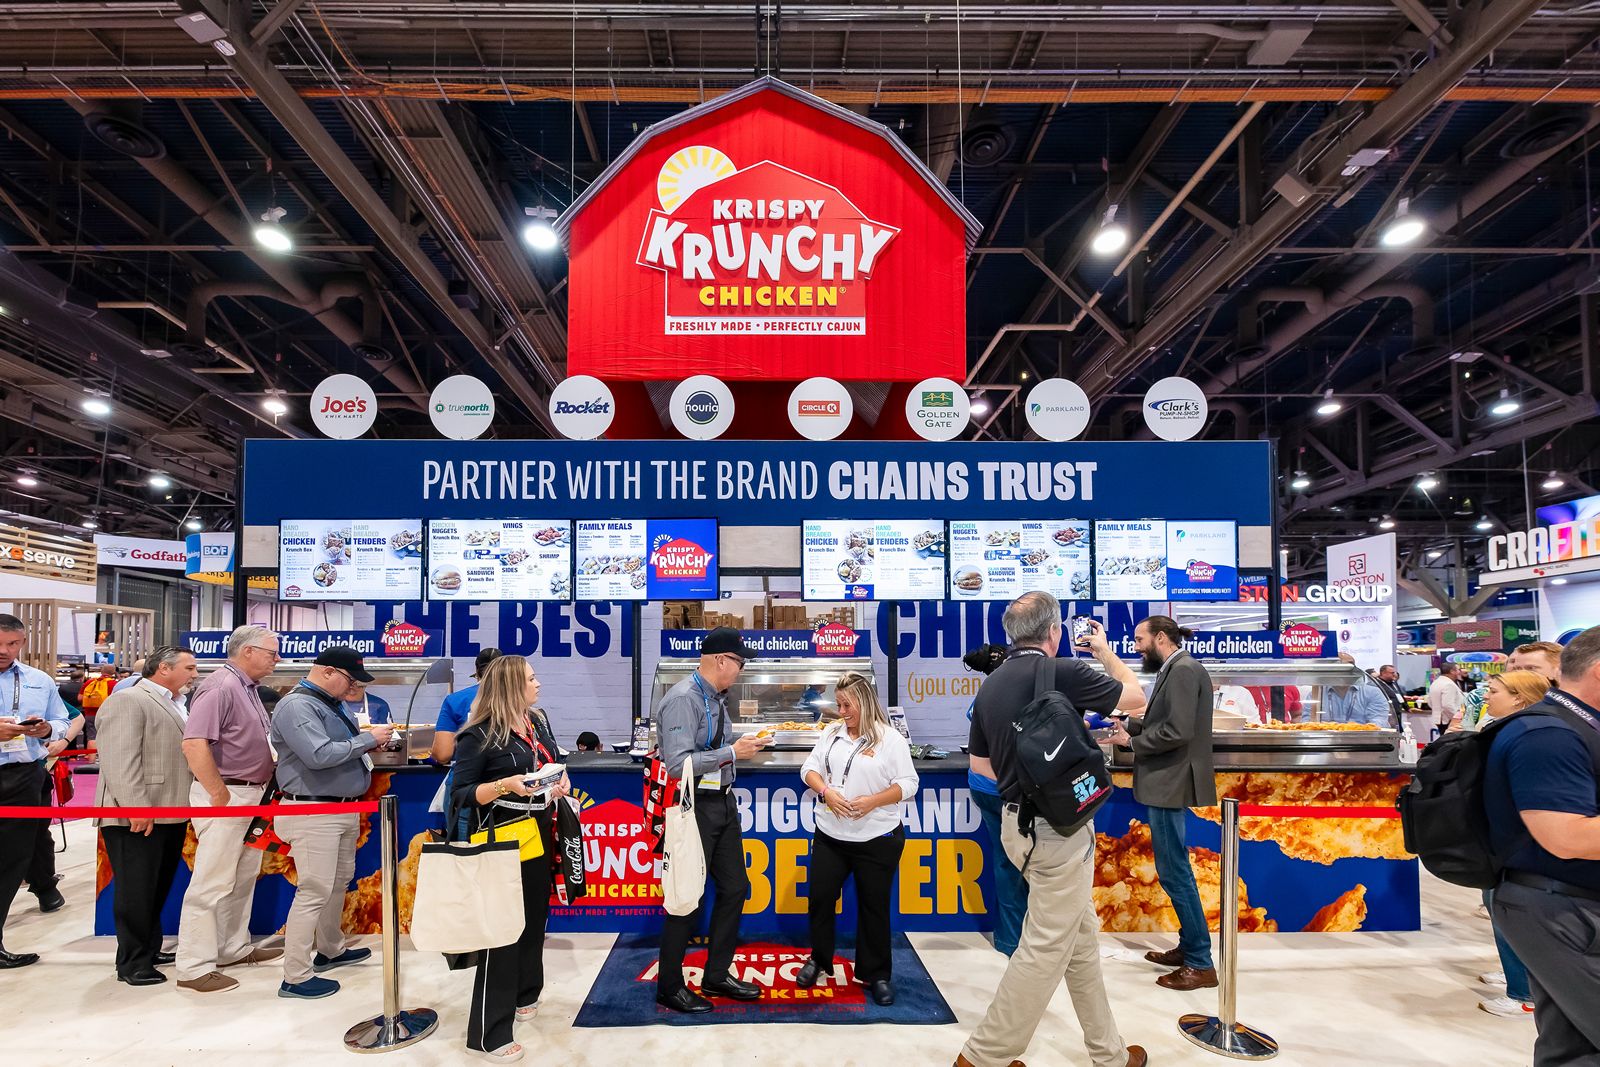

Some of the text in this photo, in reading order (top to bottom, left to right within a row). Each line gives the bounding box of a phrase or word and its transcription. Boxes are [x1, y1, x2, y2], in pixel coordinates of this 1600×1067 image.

[713, 199, 825, 220] KRISPY
[645, 216, 892, 281] KRUNCHY
[669, 321, 861, 332] FRESHLY MADE PERFECTLY CAJUN
[321, 396, 367, 413] Joe's
[448, 403, 489, 411] truenorth
[554, 398, 610, 414] Rocket
[685, 402, 719, 413] nouria
[1161, 402, 1199, 411] Clark's
[917, 410, 960, 419] GOLDEN
[925, 419, 952, 428] GATE
[423, 460, 1097, 501] PARTNER WITH THE BRAND CHAINS TRUST
[131, 549, 187, 563] Godfath
[204, 546, 228, 555] BOF
[650, 551, 714, 568] KRUNCHY
[1185, 568, 1217, 577] KRUNCHY
[1305, 584, 1392, 602] GROUP
[189, 637, 219, 654] Your
[281, 635, 317, 653] fried
[380, 632, 431, 646] KRUNCHY
[669, 637, 693, 650] Your
[742, 636, 764, 650] ried
[766, 636, 809, 650] chicken
[811, 632, 861, 646] KRUNCHY
[1217, 635, 1273, 654] chicken
[1278, 633, 1327, 647] KRUNCHY
[908, 672, 946, 703] (you
[1073, 775, 1100, 802] 32
[581, 823, 645, 837] KRISP
[741, 839, 987, 914] BEER
[585, 883, 664, 897] HICKEN
[550, 908, 583, 916] FRESHLY
[585, 908, 607, 916] MADE
[615, 908, 655, 916] PERFECTLY
[732, 953, 812, 962] RISPY
